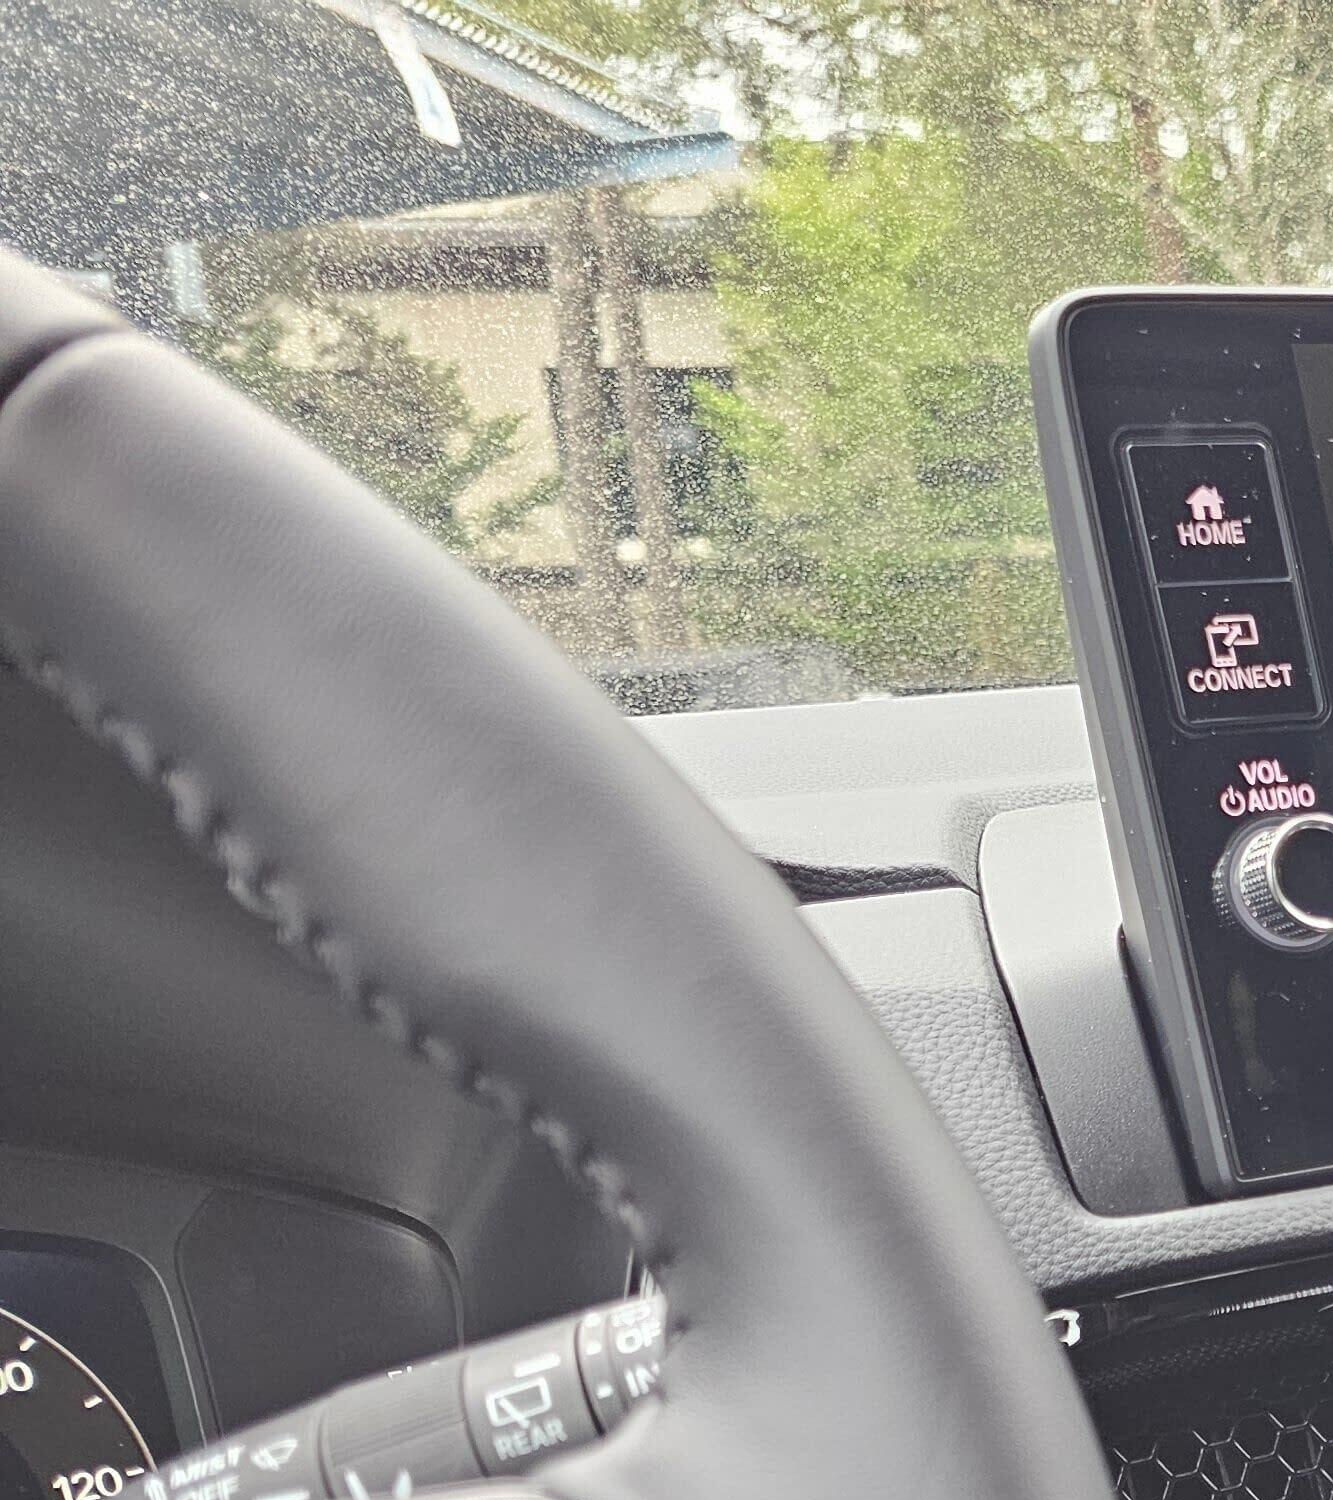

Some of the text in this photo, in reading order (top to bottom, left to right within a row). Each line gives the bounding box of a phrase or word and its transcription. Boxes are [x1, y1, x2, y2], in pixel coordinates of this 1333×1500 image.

[1177, 522, 1246, 547] HOME
[1187, 664, 1293, 692] CONNECT
[1240, 760, 1289, 786] VOL
[1247, 784, 1316, 813] AUDIO
[494, 1418, 568, 1461] REAR
